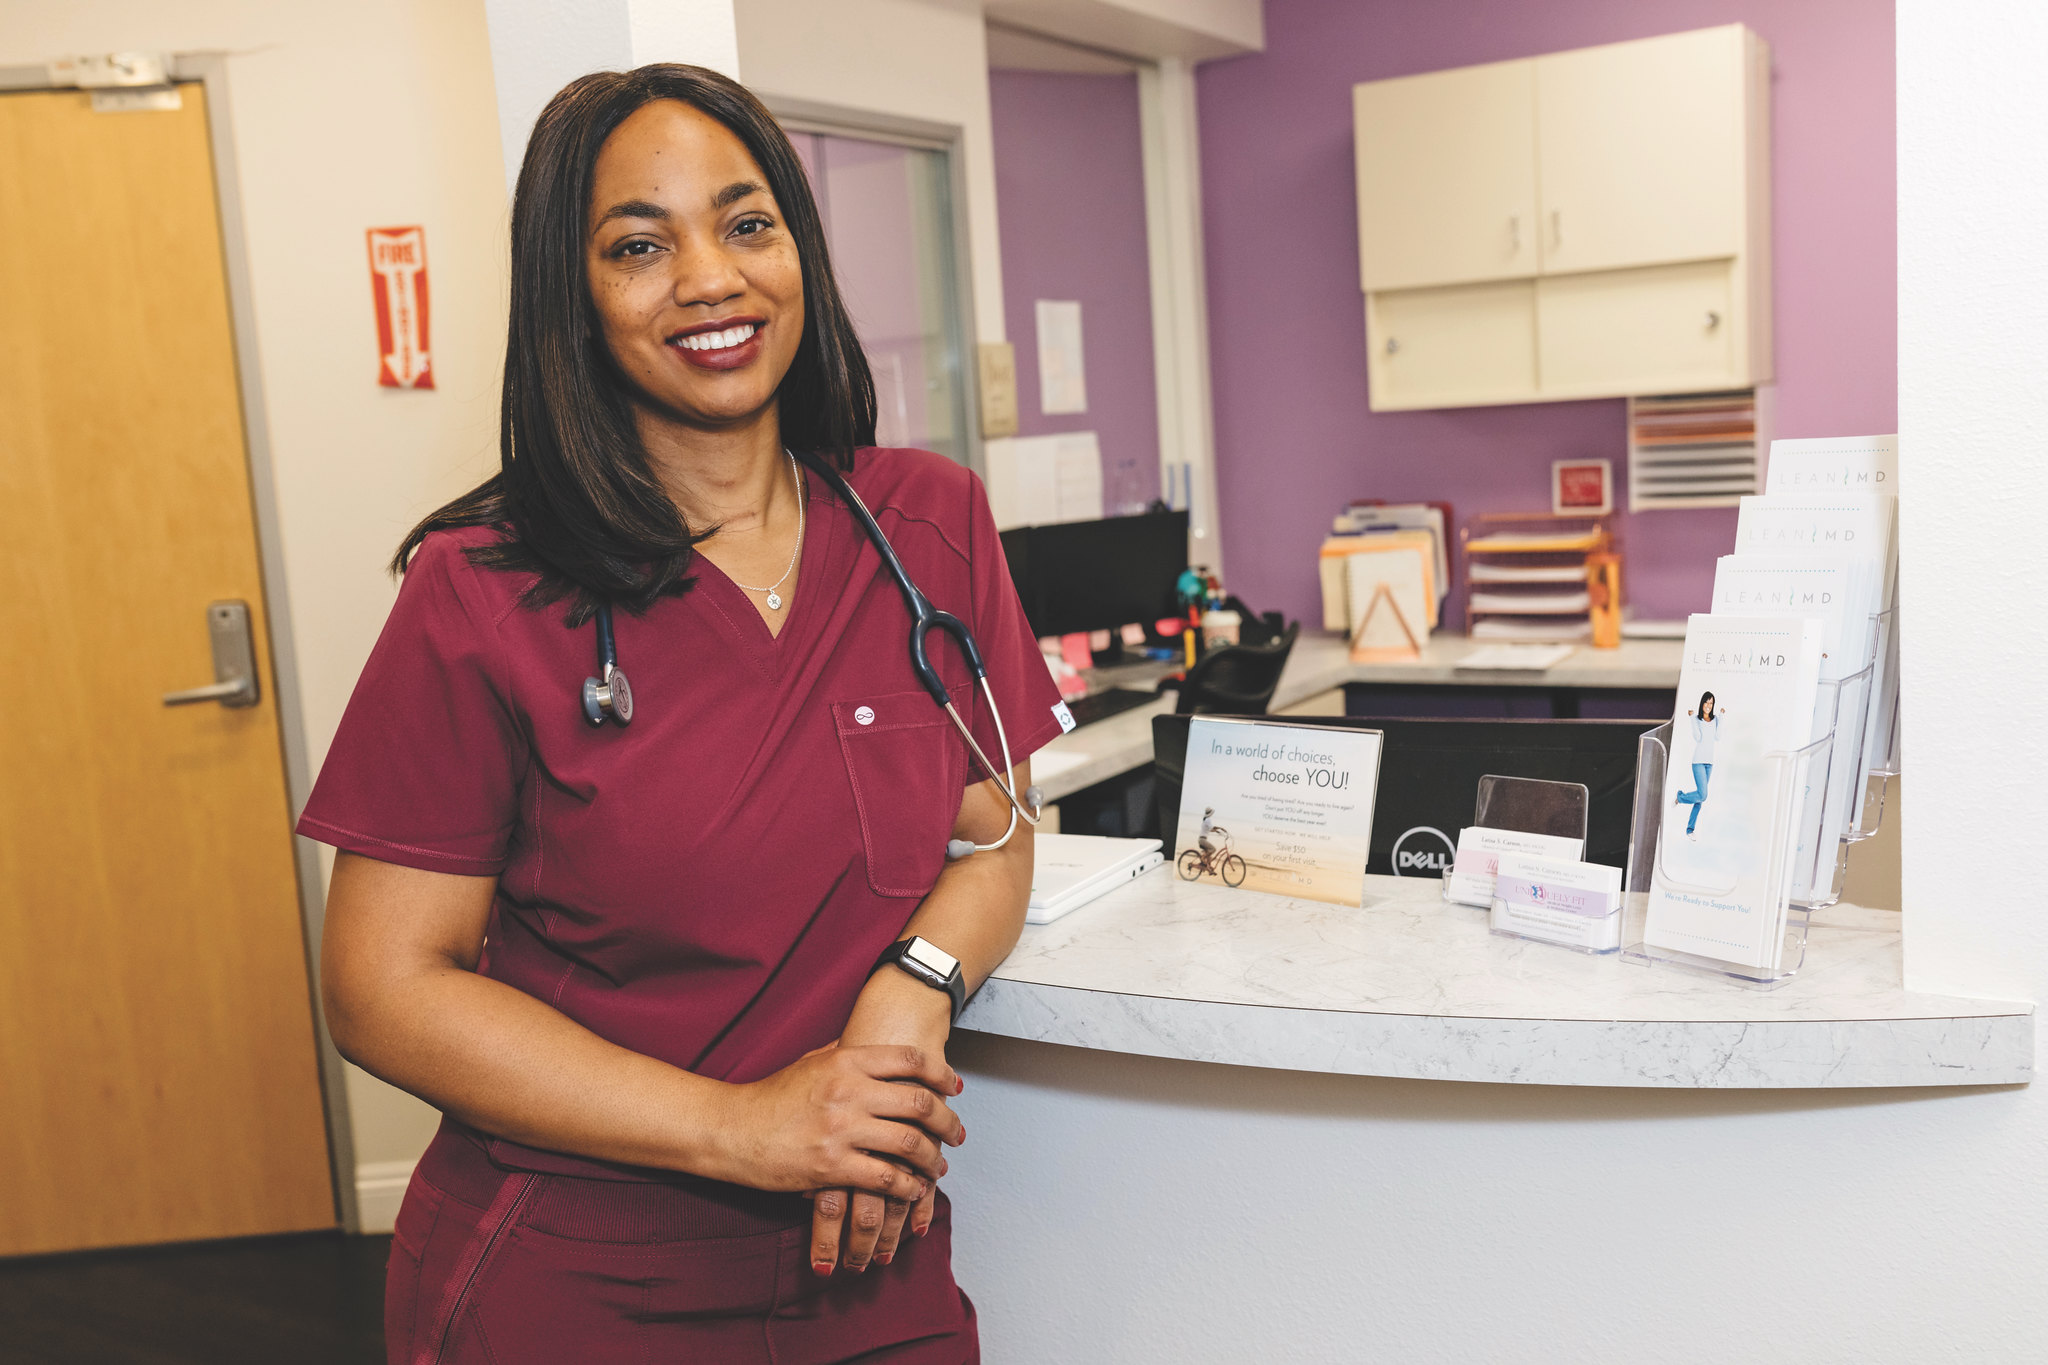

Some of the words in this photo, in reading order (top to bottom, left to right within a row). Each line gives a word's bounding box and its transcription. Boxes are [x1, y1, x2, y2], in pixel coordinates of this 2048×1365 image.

[378, 243, 415, 265] FIRE
[1779, 471, 1836, 485] LEAN
[1857, 471, 1886, 483] MD
[1749, 528, 1804, 541] LEAN
[1825, 529, 1855, 541] MD
[1724, 591, 1781, 604] LEAN
[1802, 592, 1832, 604] MD
[1693, 652, 1742, 665] LEAN
[1759, 654, 1786, 667] MD
[1211, 738, 1222, 755] In
[1225, 745, 1233, 756] a
[1236, 743, 1269, 759] world
[1271, 744, 1286, 760] of
[1287, 746, 1336, 767] choices,
[1253, 764, 1300, 785] choose
[1306, 767, 1350, 790] YOU!
[1276, 841, 1291, 852] Save
[1293, 844, 1306, 855] $50
[1272, 854, 1288, 864] your
[1288, 853, 1302, 864] first
[1399, 850, 1446, 870] DELL
[1682, 894, 1701, 905] Ready
[1710, 899, 1735, 912] Support
